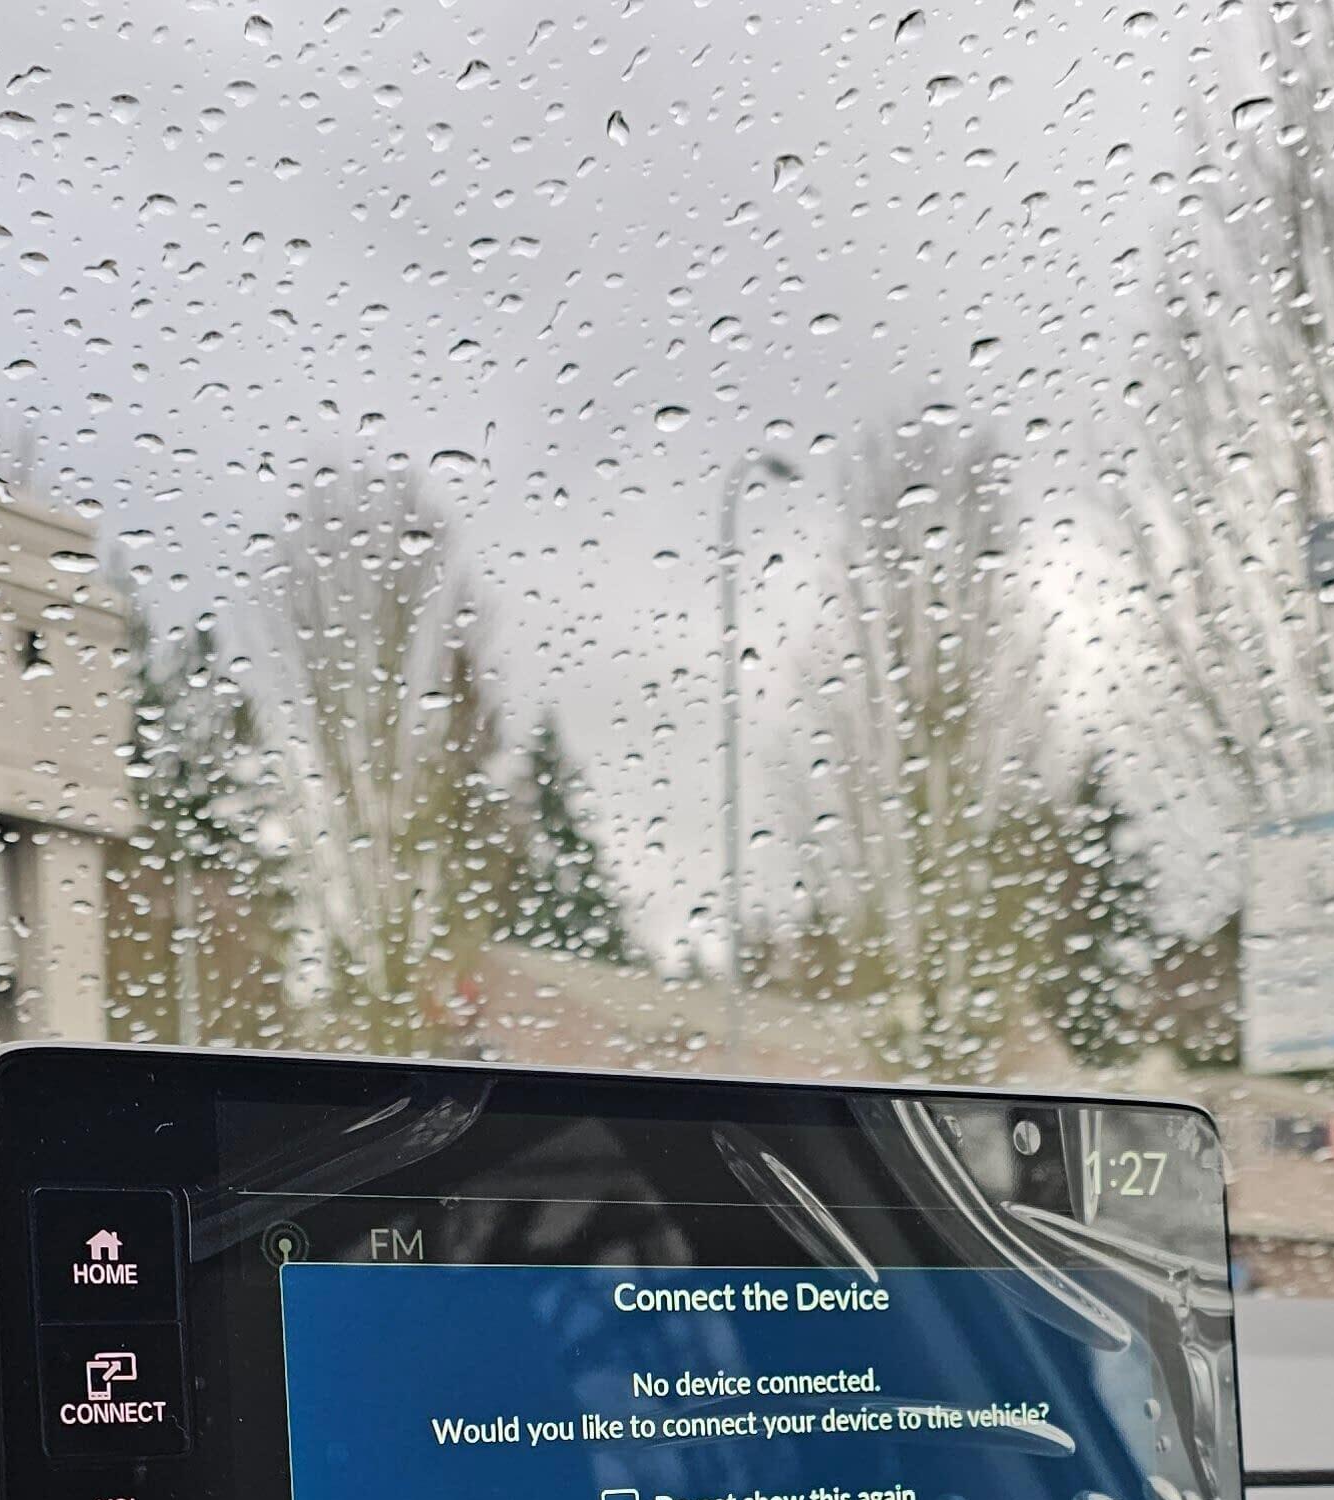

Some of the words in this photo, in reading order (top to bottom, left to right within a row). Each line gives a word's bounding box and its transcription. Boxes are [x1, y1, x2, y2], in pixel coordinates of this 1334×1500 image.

[1084, 1150, 1168, 1196] 1:27
[370, 1228, 424, 1261] FM
[72, 1263, 139, 1286] HOME
[612, 1282, 736, 1312] Connect
[742, 1281, 792, 1312] the
[796, 1281, 891, 1312] Device
[632, 1372, 669, 1398] No
[675, 1370, 751, 1397] device
[756, 1367, 882, 1396] connected.
[59, 1400, 167, 1426] CONNECT
[431, 1416, 520, 1446] Would
[526, 1420, 575, 1447] you
[582, 1413, 624, 1442] like
[629, 1416, 655, 1440] to
[662, 1412, 757, 1439] connect
[762, 1410, 816, 1440] your
[821, 1403, 893, 1432] device
[897, 1406, 923, 1431] to
[927, 1402, 963, 1430] the
[967, 1401, 1050, 1428] vehicle?
